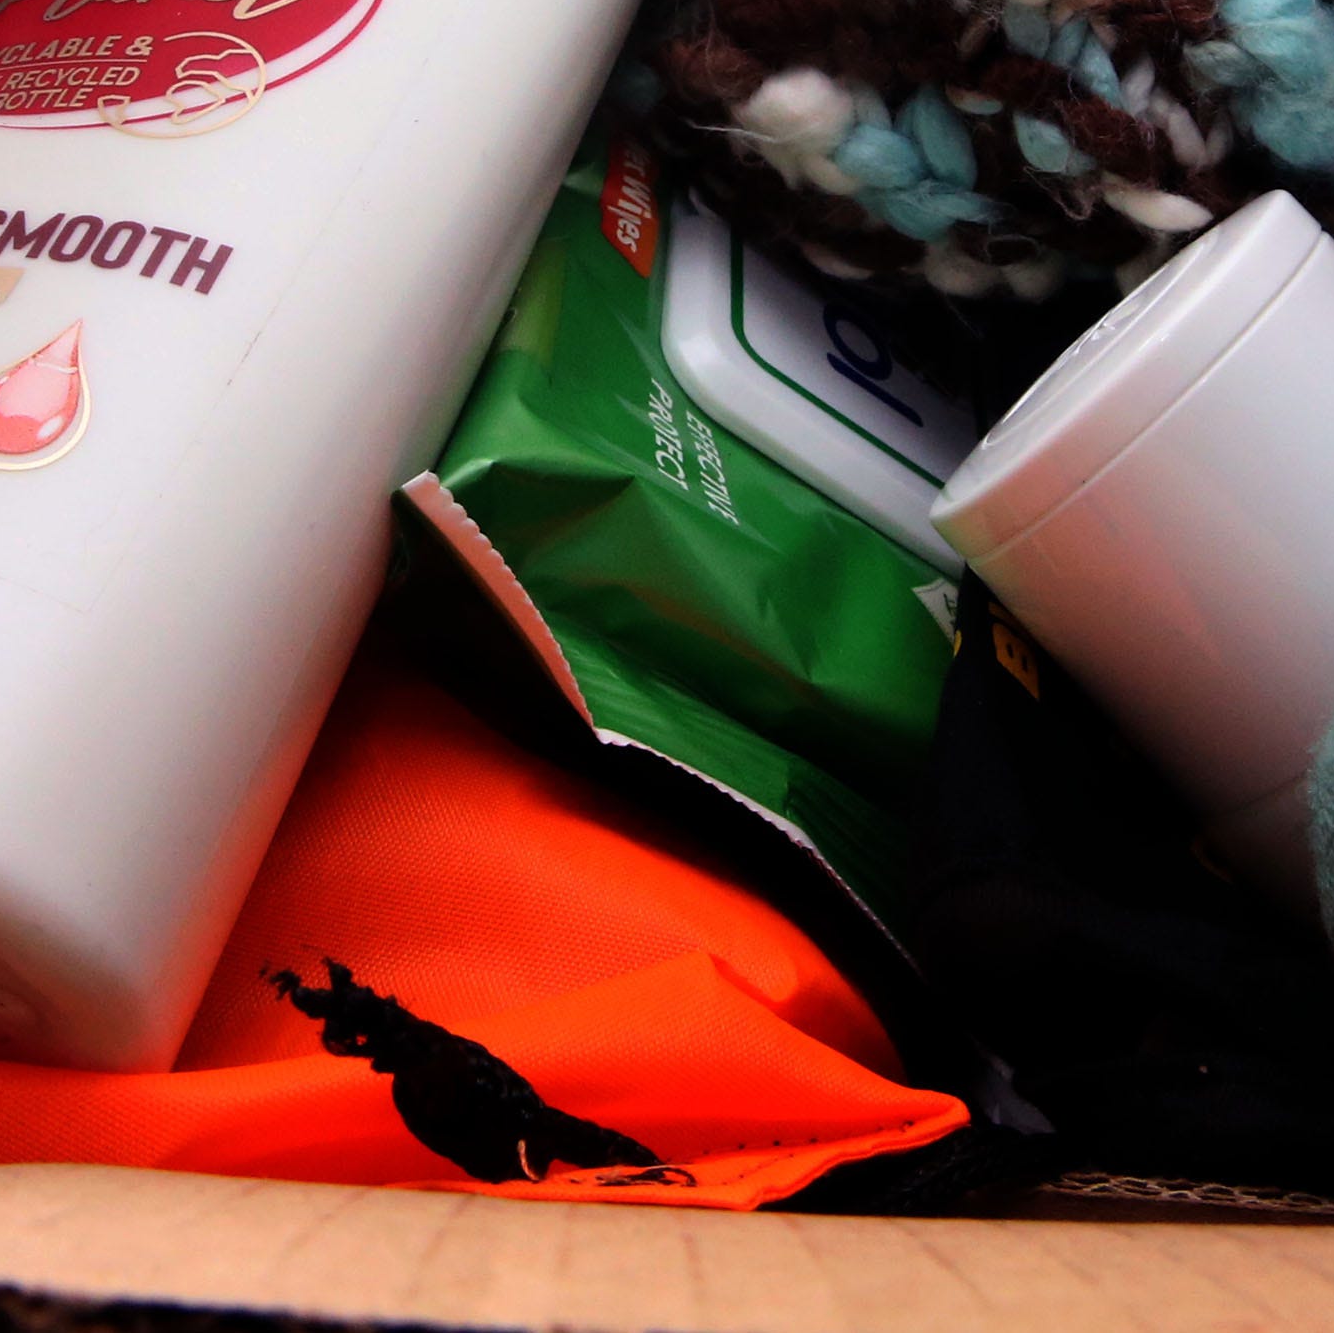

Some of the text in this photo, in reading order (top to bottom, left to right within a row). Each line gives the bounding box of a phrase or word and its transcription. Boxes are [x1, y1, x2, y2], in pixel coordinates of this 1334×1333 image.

[1, 66, 141, 91] RECYCLED
[125, 35, 154, 57] &
[648, 377, 689, 492] PROTECT
[685, 410, 740, 526] EFFECTIVE
